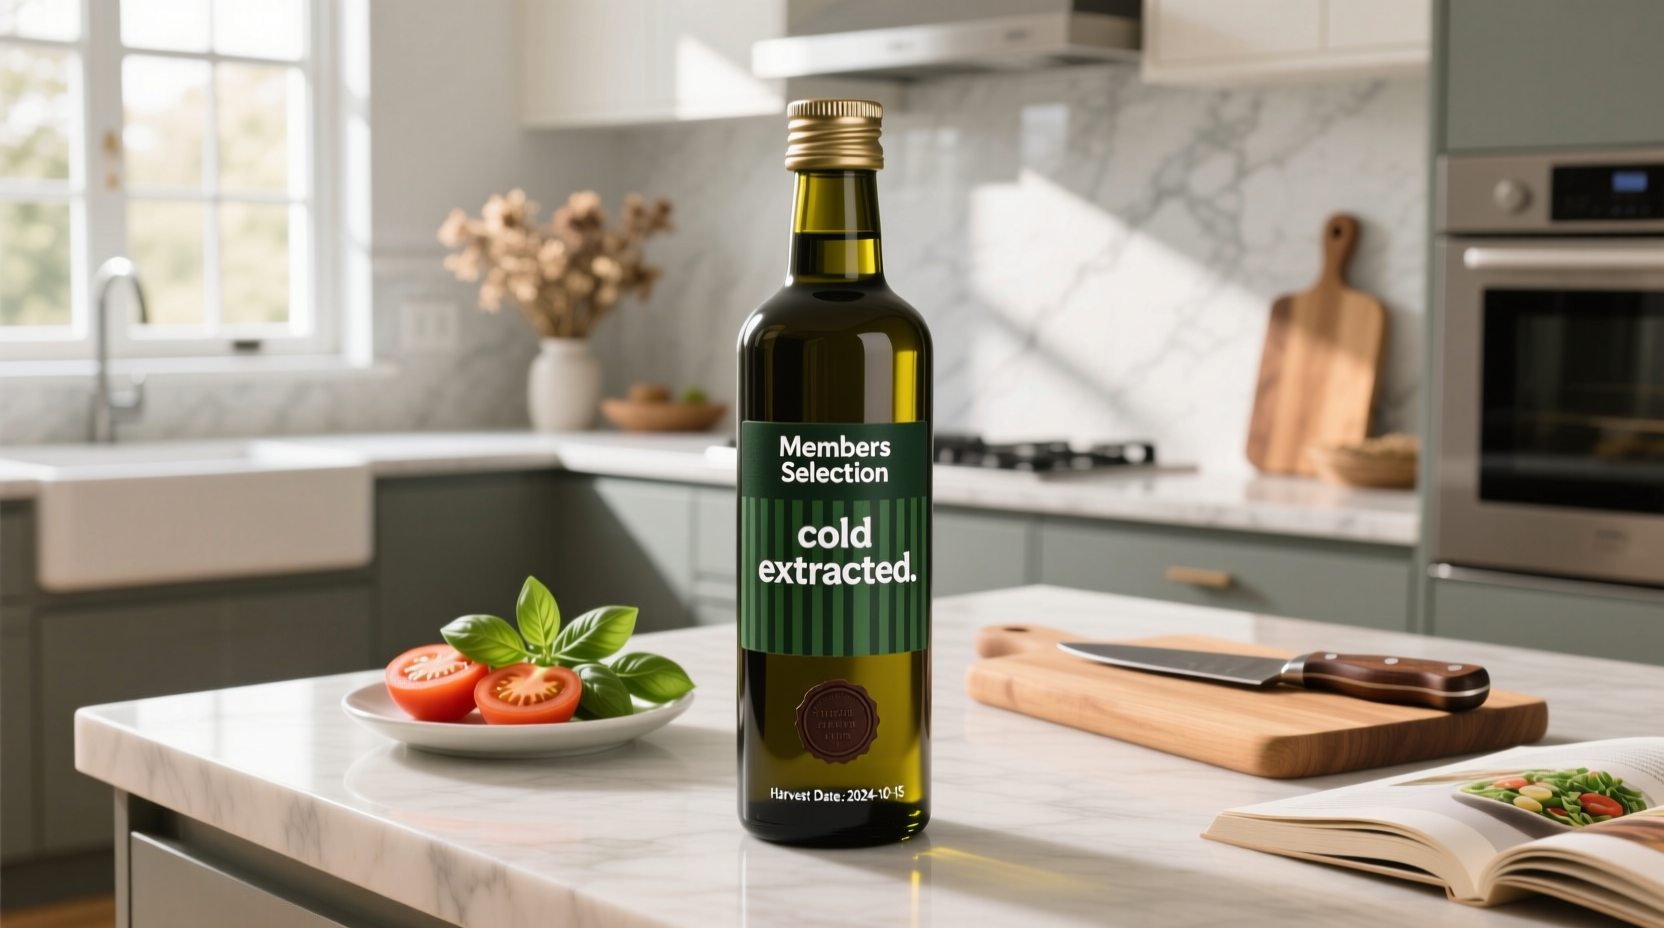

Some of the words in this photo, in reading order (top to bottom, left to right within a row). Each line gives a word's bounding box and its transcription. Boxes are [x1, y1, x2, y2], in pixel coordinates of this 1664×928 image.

[779, 434, 891, 458] Members
[781, 461, 889, 484] Selection
[797, 516, 872, 549] cold
[758, 551, 917, 585] extracted.
[770, 787, 811, 802] Harvest
[814, 789, 845, 802] Date:
